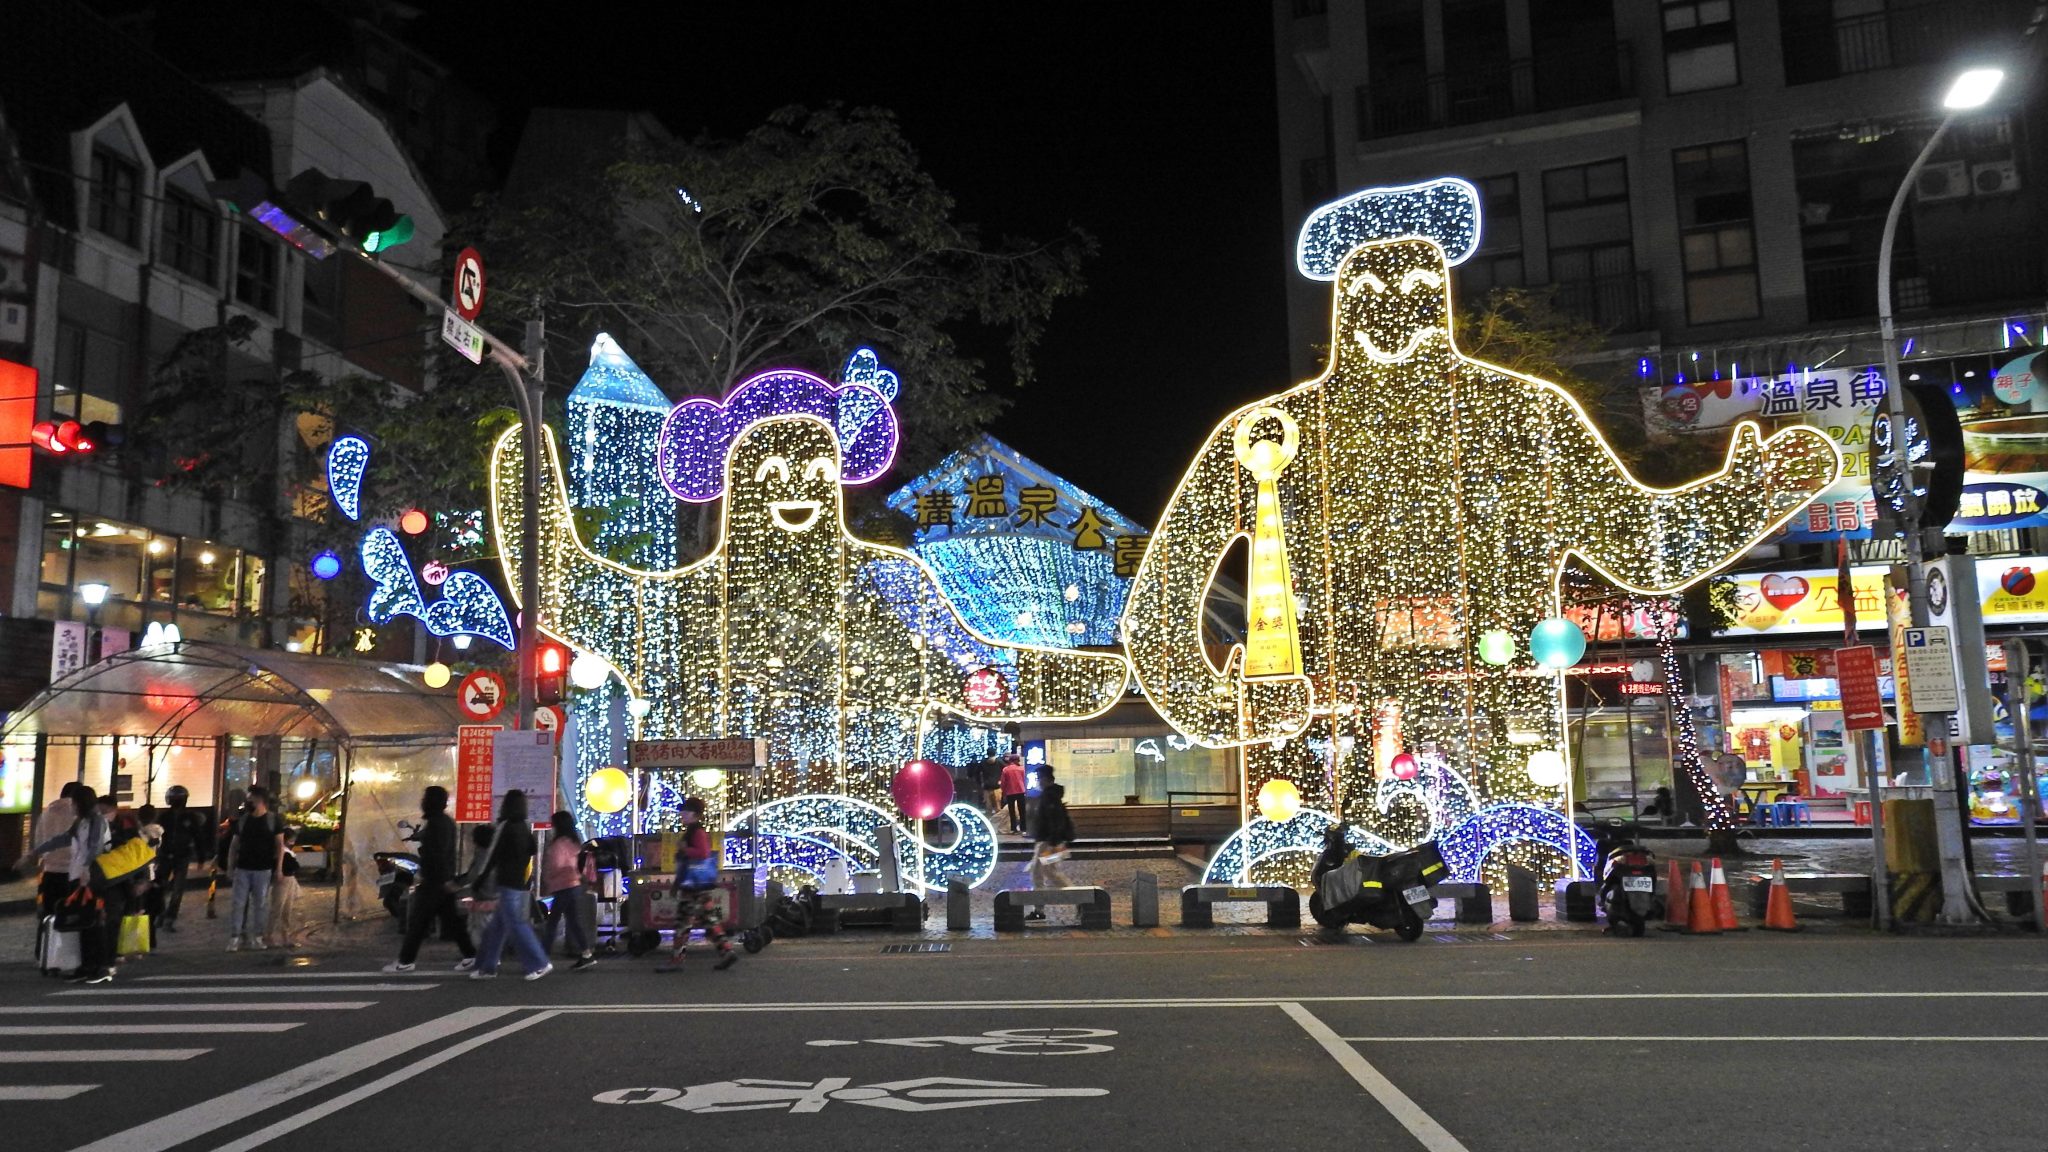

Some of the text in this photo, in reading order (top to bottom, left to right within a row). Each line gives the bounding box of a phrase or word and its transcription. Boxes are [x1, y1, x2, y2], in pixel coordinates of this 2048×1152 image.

[1996, 372, 2034, 389] 親子
[1760, 371, 1887, 415] 溫泉魚
[1909, 632, 1922, 647] P
